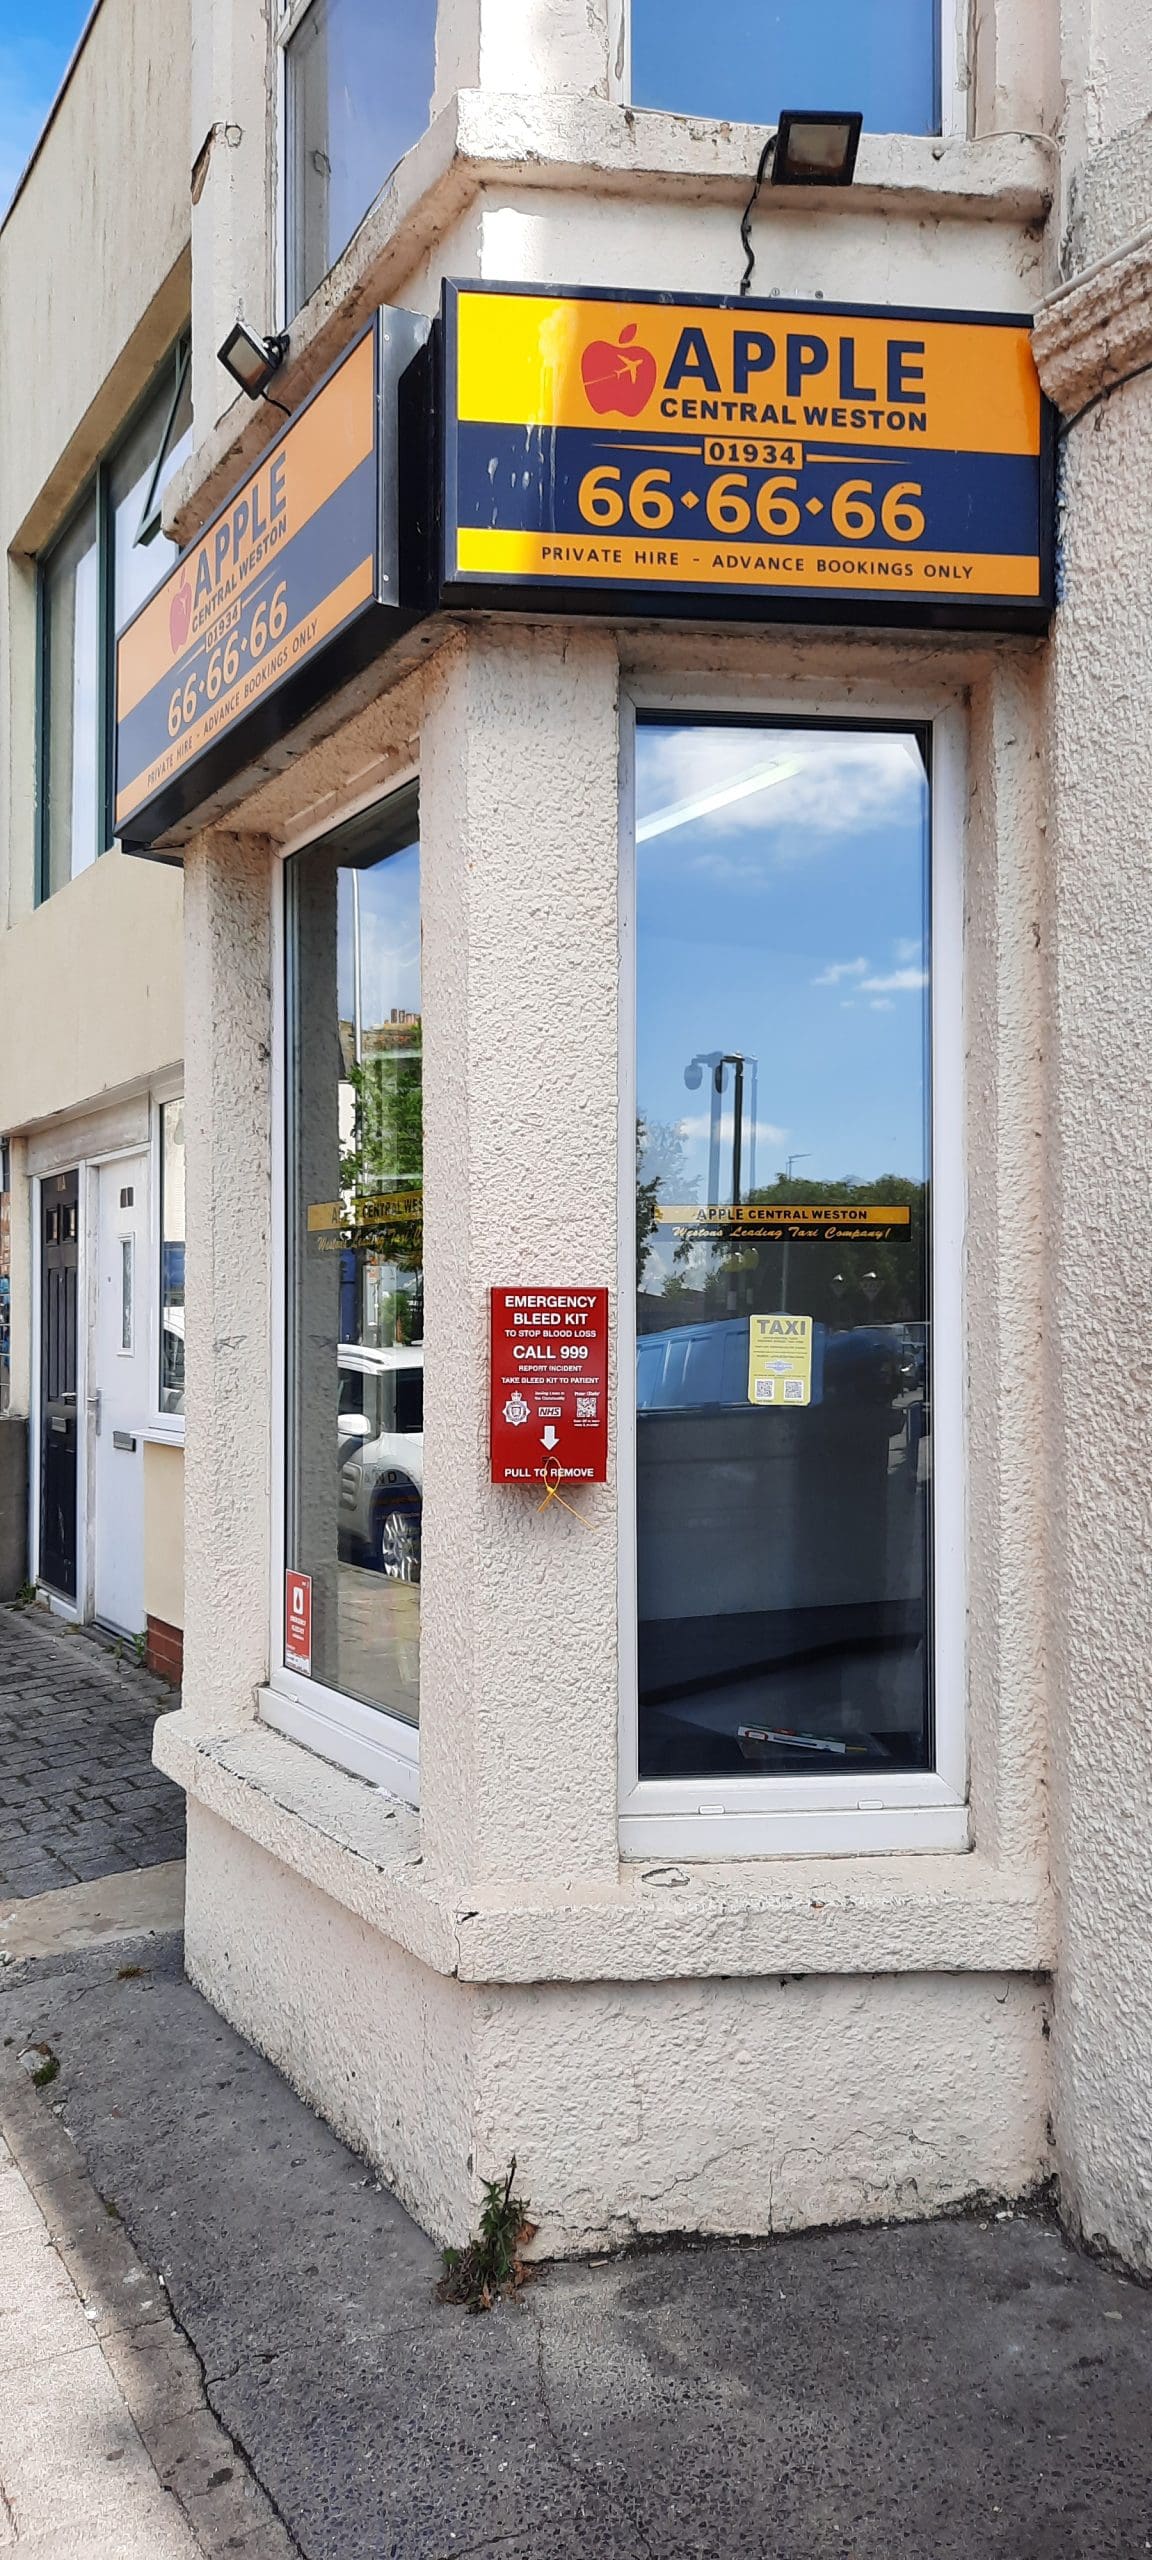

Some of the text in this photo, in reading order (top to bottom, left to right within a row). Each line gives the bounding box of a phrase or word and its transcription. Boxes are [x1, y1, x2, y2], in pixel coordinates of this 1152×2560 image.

[663, 325, 927, 404] APPLE
[660, 397, 928, 432] CENTRAL WESTON
[708, 443, 796, 466] 01934
[193, 451, 287, 610] APPLE
[541, 546, 623, 564] PRIVATE
[634, 551, 679, 566] HIRE
[712, 554, 805, 572] ADVANCE
[816, 559, 914, 578] BOOKINGS
[923, 564, 974, 580] ONLY
[192, 514, 287, 633] CENTRAL WESTON
[207, 604, 239, 648] 01934
[147, 755, 174, 787] PRIVATE
[176, 735, 193, 759] HIRE
[203, 692, 240, 736] ADVANCE
[244, 647, 289, 697] BOOKINGS
[291, 618, 318, 654] ONLY
[696, 1208, 867, 1220] APPLE CENTRAL WESTON
[672, 1226, 892, 1240] Westons Leading Taxi Company!
[504, 1295, 597, 1308] EMERGENCY
[513, 1313, 589, 1325] BLEED KIT
[504, 1329, 597, 1338] TO STOP BLOOD LOSS
[756, 1319, 806, 1336] TAXI
[512, 1345, 589, 1359] CALL 999
[501, 1376, 520, 1384] TAKE
[539, 1407, 560, 1416] NHS
[504, 1468, 595, 1477] PULL TO REMOVE
